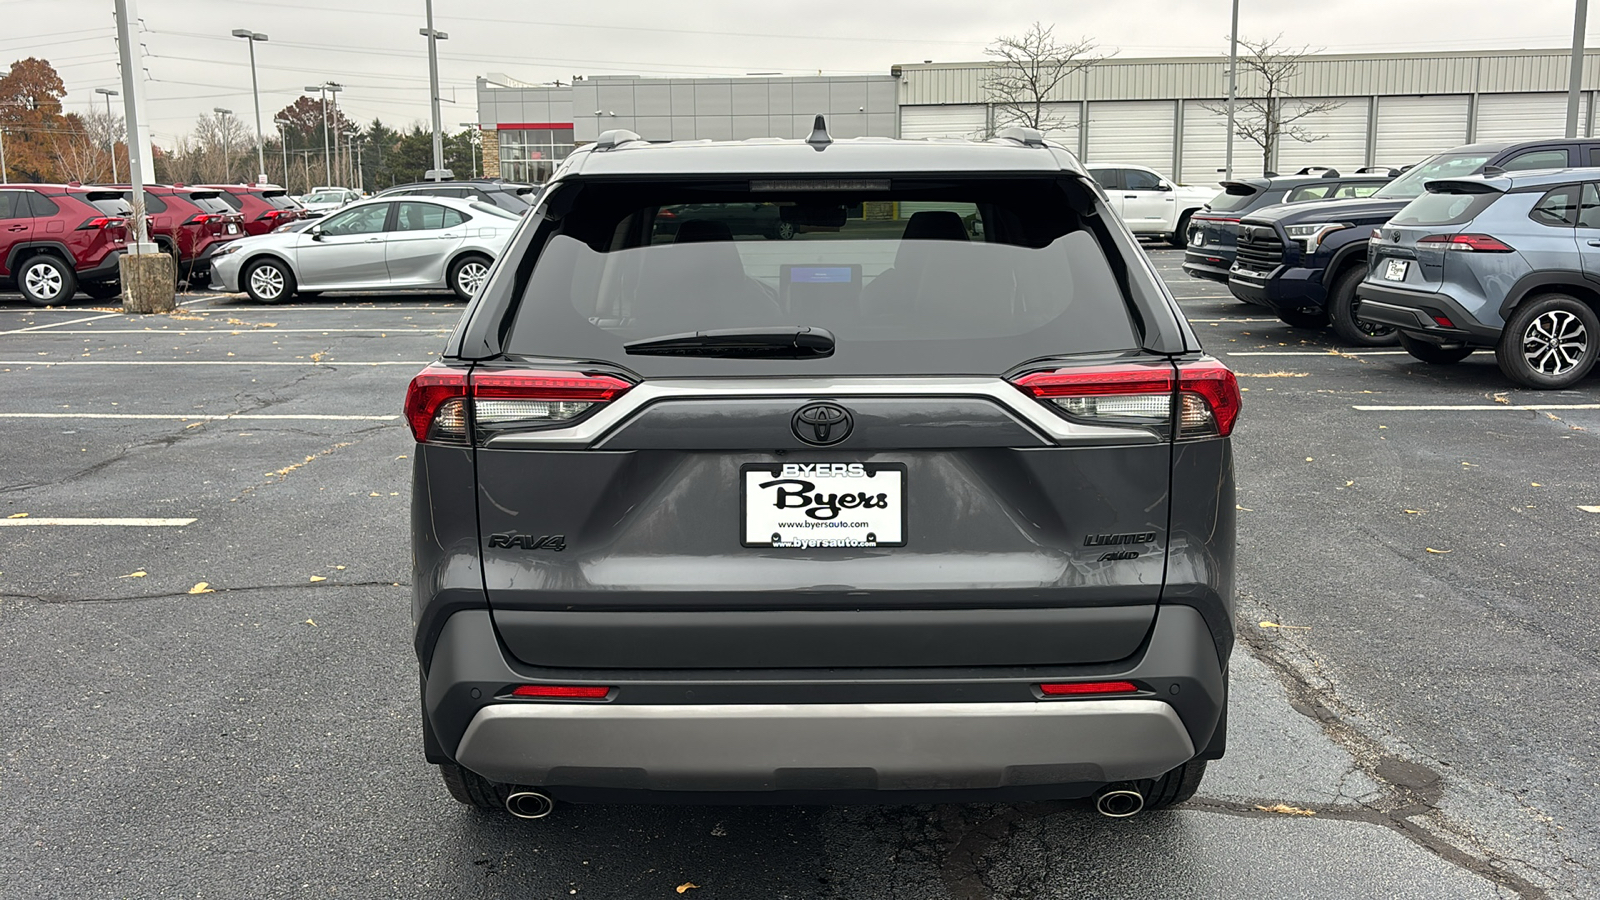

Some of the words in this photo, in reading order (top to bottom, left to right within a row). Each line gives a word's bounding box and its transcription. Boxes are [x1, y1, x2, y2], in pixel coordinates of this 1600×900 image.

[782, 463, 865, 478] BYERS
[758, 479, 888, 520] Byers
[778, 520, 869, 530] www.byersauto.com
[488, 533, 567, 551] RAV4
[772, 537, 877, 550] www.byersauto.com
[1083, 531, 1157, 546] LIMITED
[1097, 550, 1140, 562] AWD
